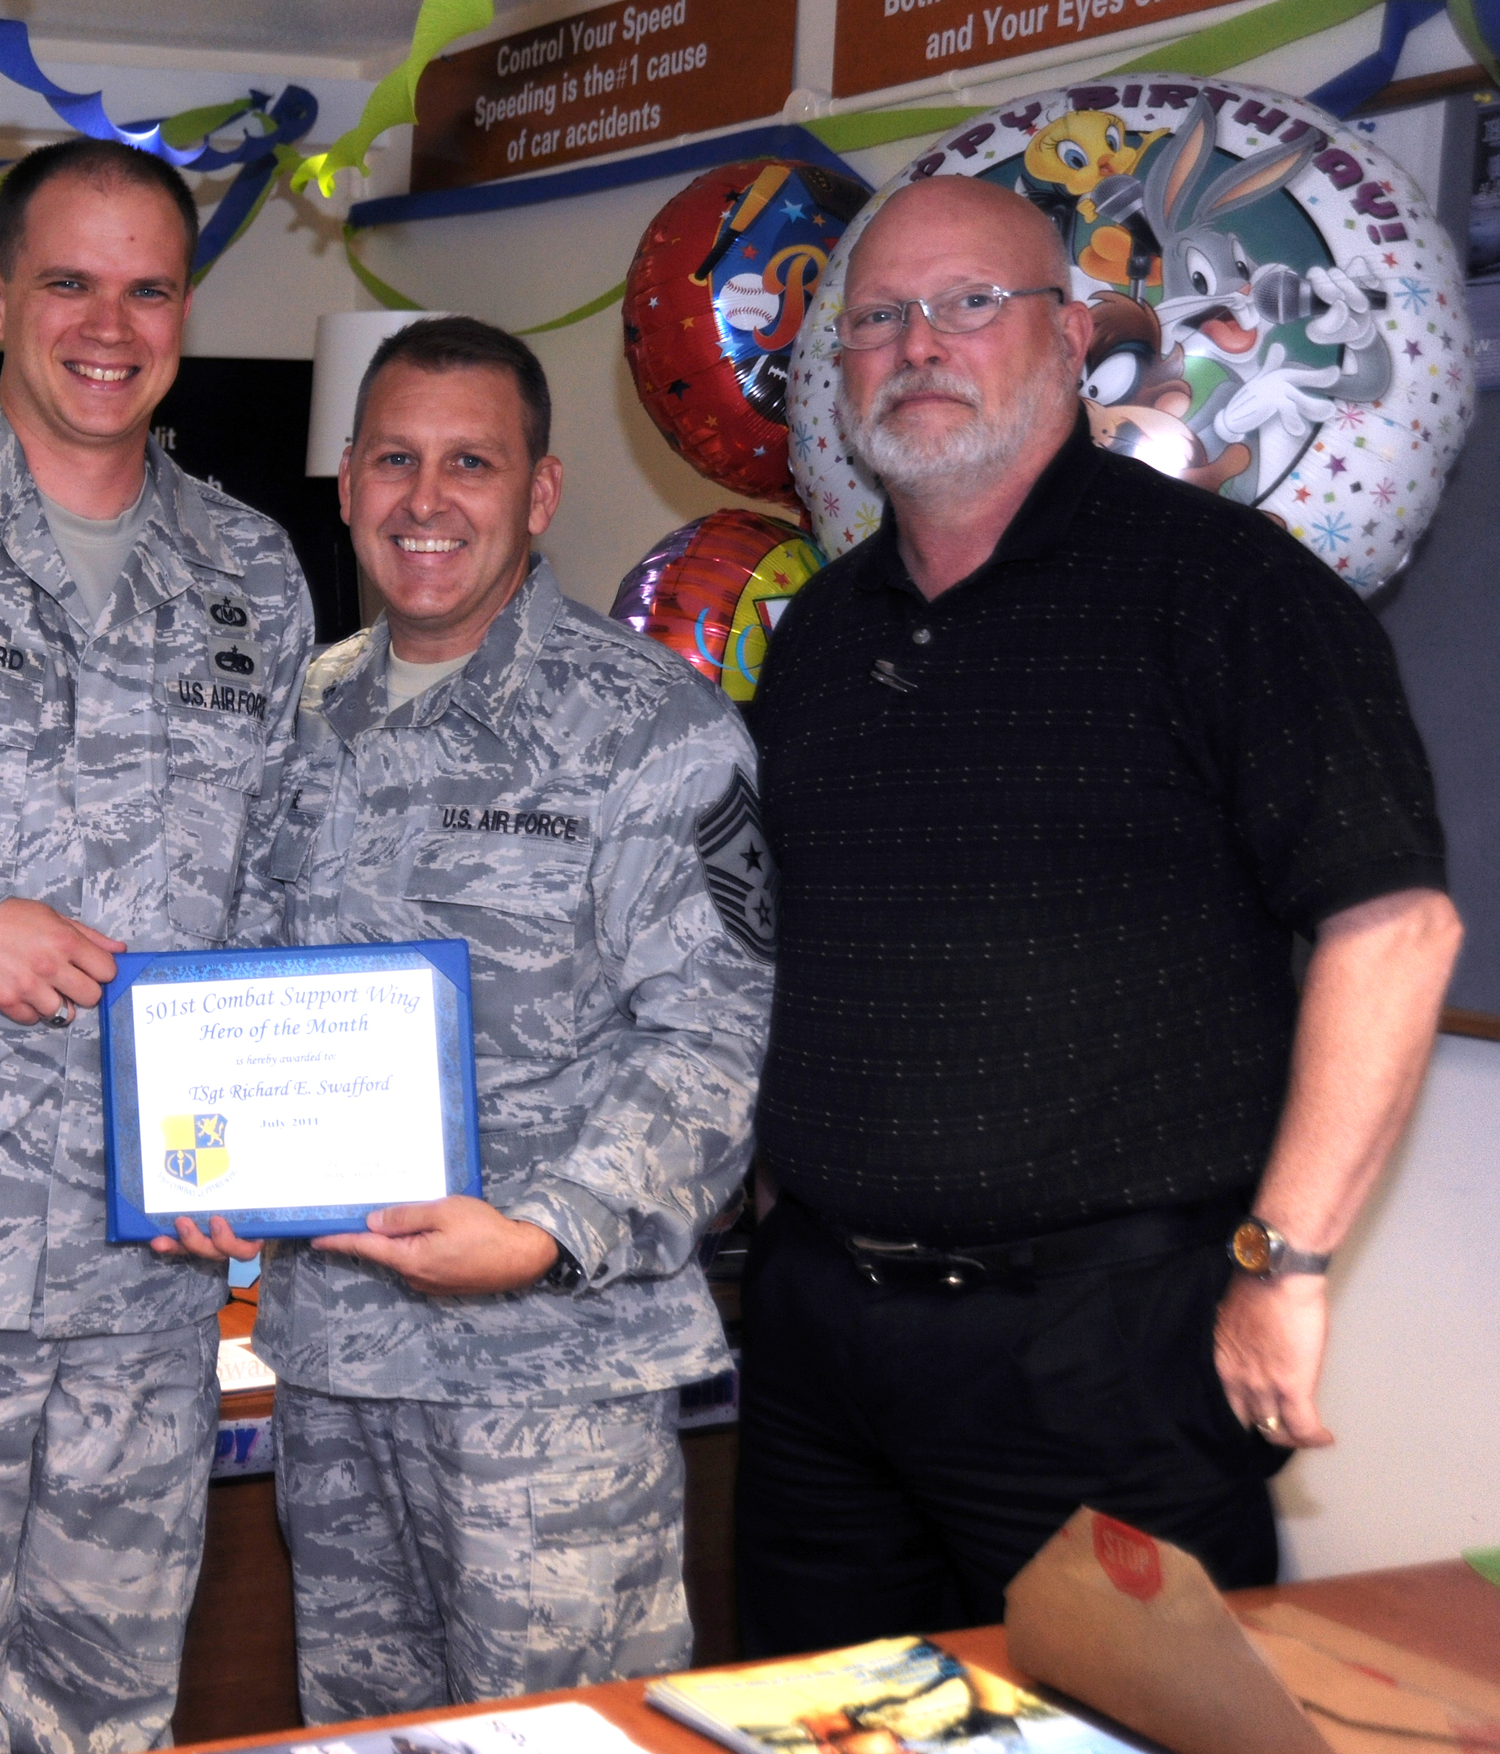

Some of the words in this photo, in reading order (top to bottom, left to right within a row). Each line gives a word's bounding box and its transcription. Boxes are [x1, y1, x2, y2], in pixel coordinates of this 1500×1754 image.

[497, 28, 564, 77] Control
[570, 18, 617, 54] Your
[622, 0, 687, 45] Speed
[925, 14, 974, 60] and
[982, 2, 1049, 46] Your
[1057, 0, 1124, 32] Eyes
[474, 82, 556, 131] Speeding
[562, 72, 578, 104] is
[646, 42, 708, 82] cause
[507, 128, 527, 163] of
[531, 129, 560, 158] car
[565, 103, 661, 149] accidents
[179, 680, 207, 708] U.S.
[211, 684, 236, 714] AIR
[443, 808, 472, 830] U.S.
[478, 810, 509, 833] AIR
[514, 813, 579, 841] FORCE
[146, 998, 196, 1025] 501st
[203, 986, 275, 1014] Combat
[280, 986, 359, 1010] Support
[366, 984, 420, 1014] Wing
[199, 1022, 243, 1041] Hero
[249, 1018, 271, 1043] of
[273, 1017, 300, 1036] the
[306, 1013, 369, 1035] Month
[236, 1057, 244, 1066] is
[246, 1053, 277, 1067] hereby
[279, 1051, 323, 1064] awarded
[324, 1052, 337, 1061] to:
[188, 1084, 225, 1105] TSgt
[230, 1079, 293, 1101] Richard
[293, 1081, 311, 1096] E.
[316, 1074, 394, 1098] Swafford
[259, 1118, 285, 1130] July
[292, 1117, 319, 1127] 2011
